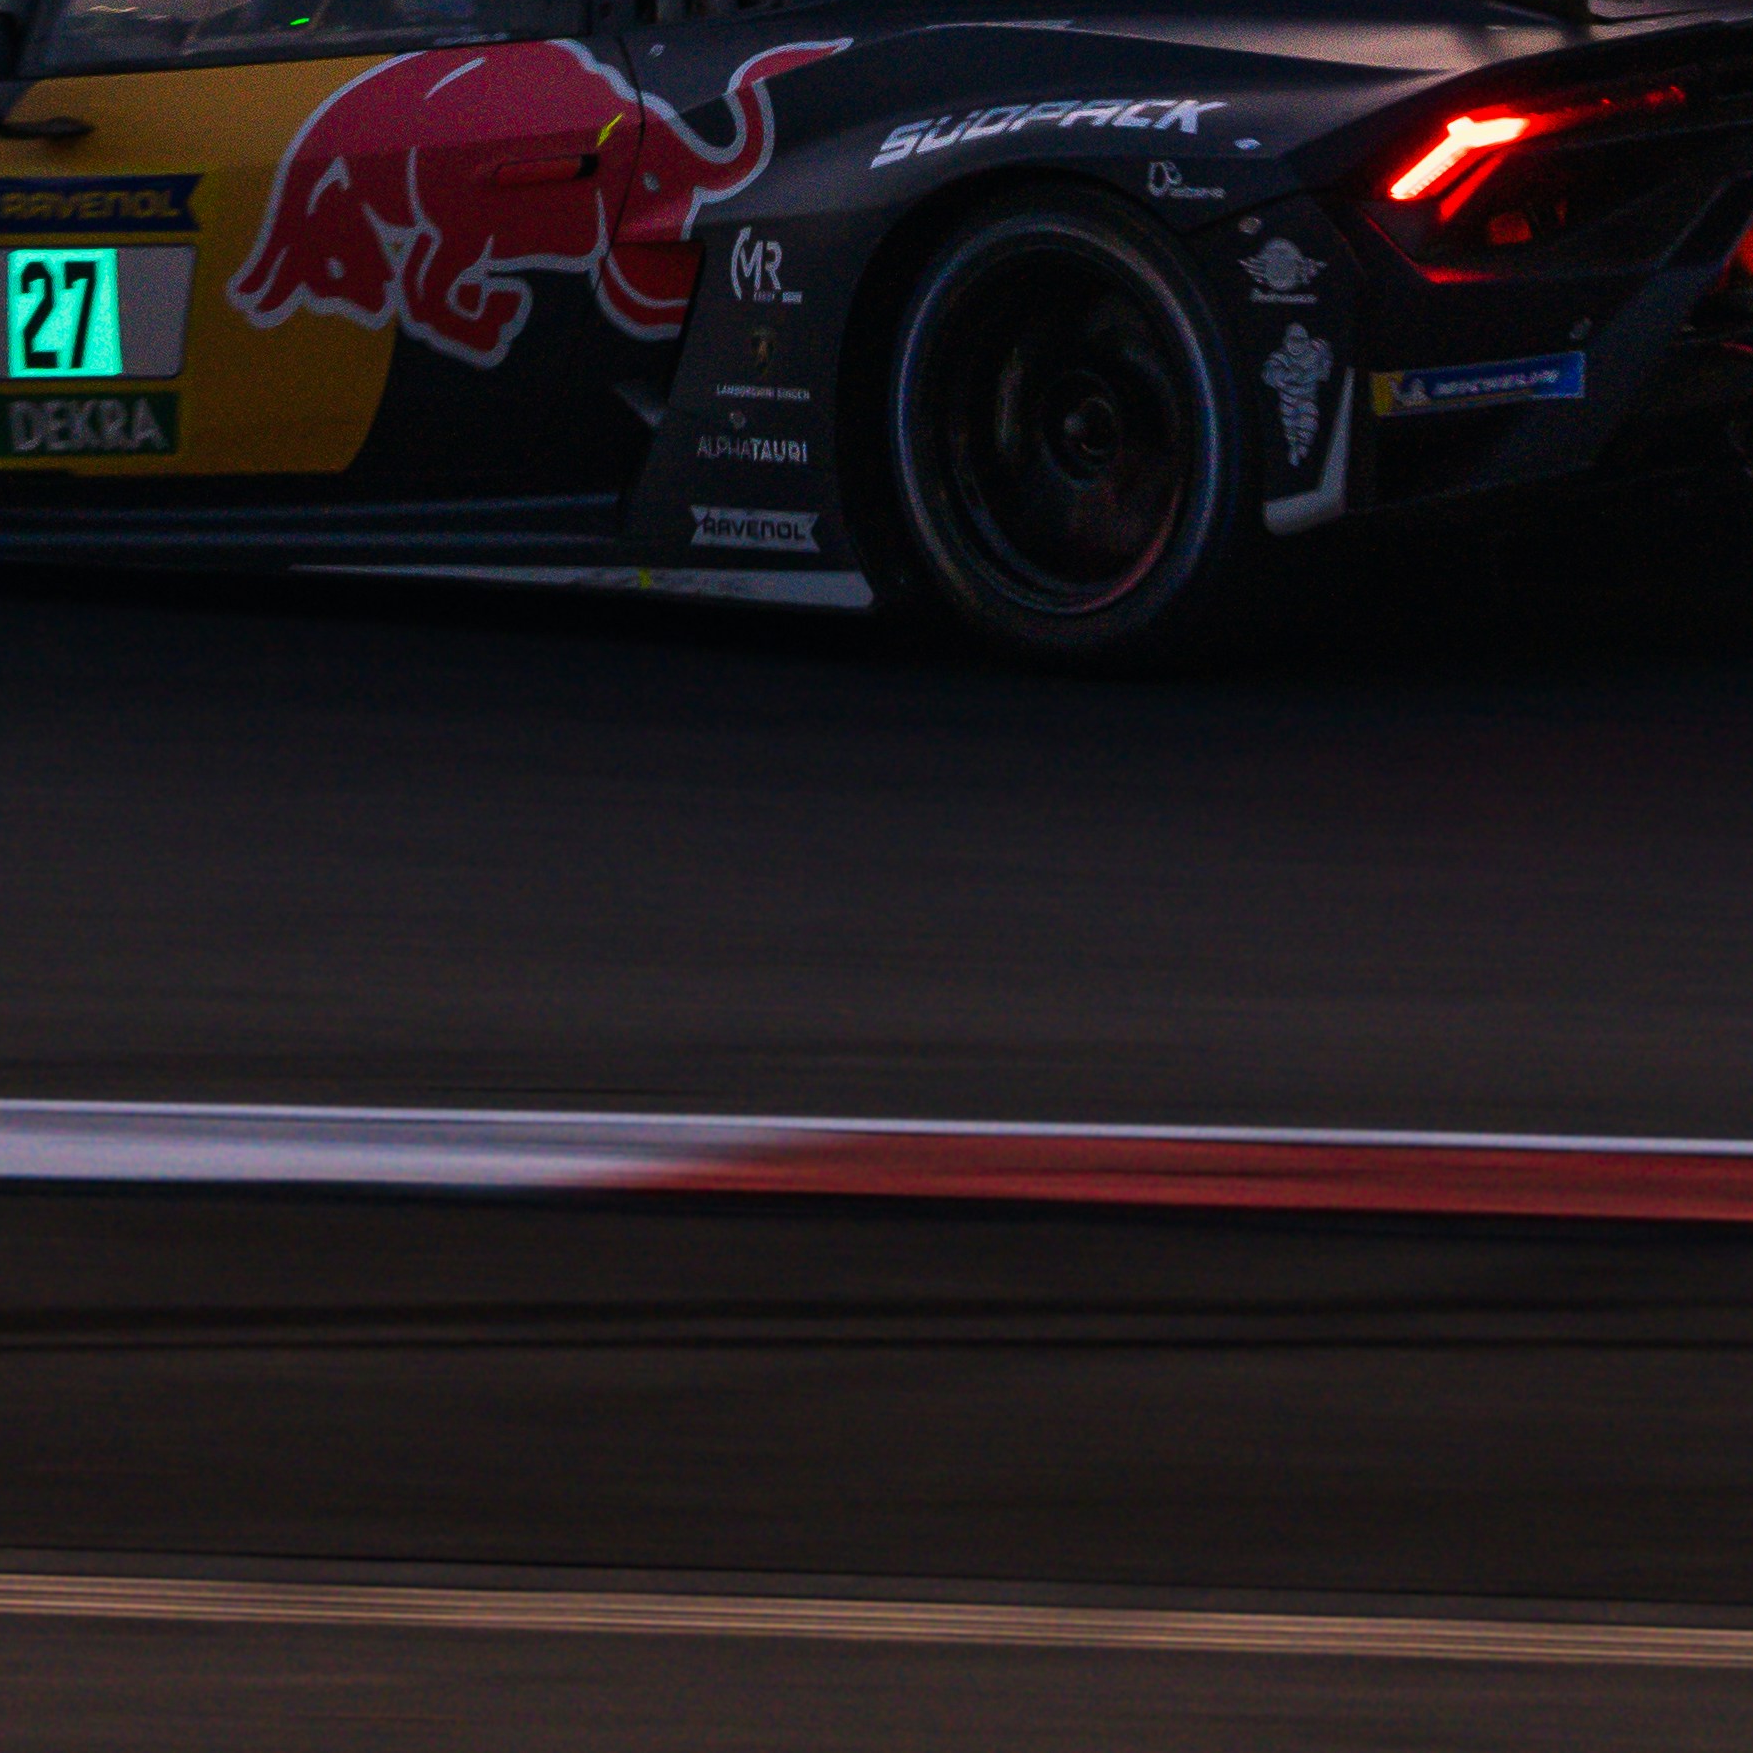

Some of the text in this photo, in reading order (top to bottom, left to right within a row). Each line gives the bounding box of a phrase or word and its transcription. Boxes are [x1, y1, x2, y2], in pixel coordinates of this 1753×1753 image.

[0, 189, 182, 221] RAVENOL
[21, 260, 97, 369] 27
[8, 397, 170, 453] DEKRA
[701, 514, 807, 541] RAVENOL
